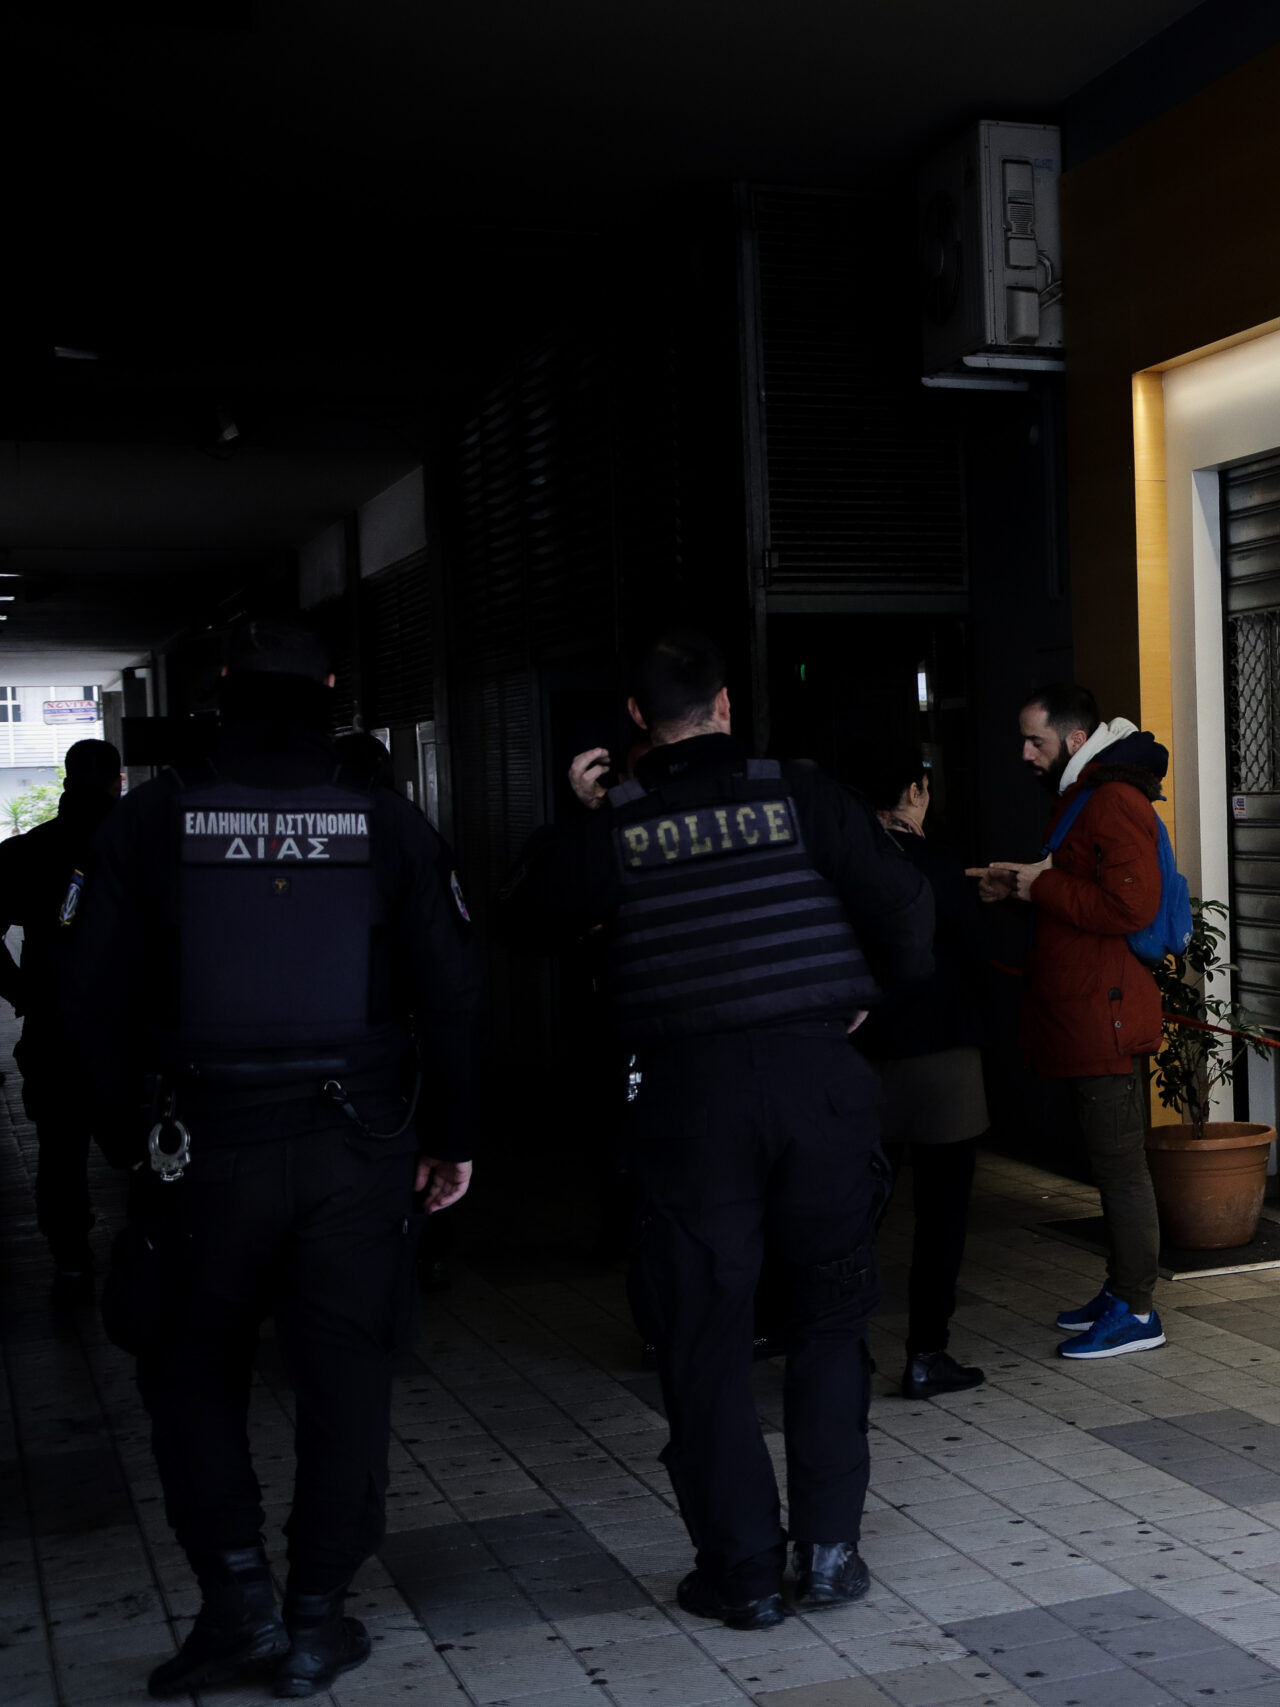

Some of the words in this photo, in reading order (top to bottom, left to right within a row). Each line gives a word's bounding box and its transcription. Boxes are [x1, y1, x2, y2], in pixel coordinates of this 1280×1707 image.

[184, 811, 269, 836] ΕΛΛΗΝΙΚΗ
[275, 812, 368, 836] ΑΣΤΥΝΟΜΙΑ
[624, 803, 790, 866] POLICE
[224, 837, 331, 860] ΔΙΑΣ
